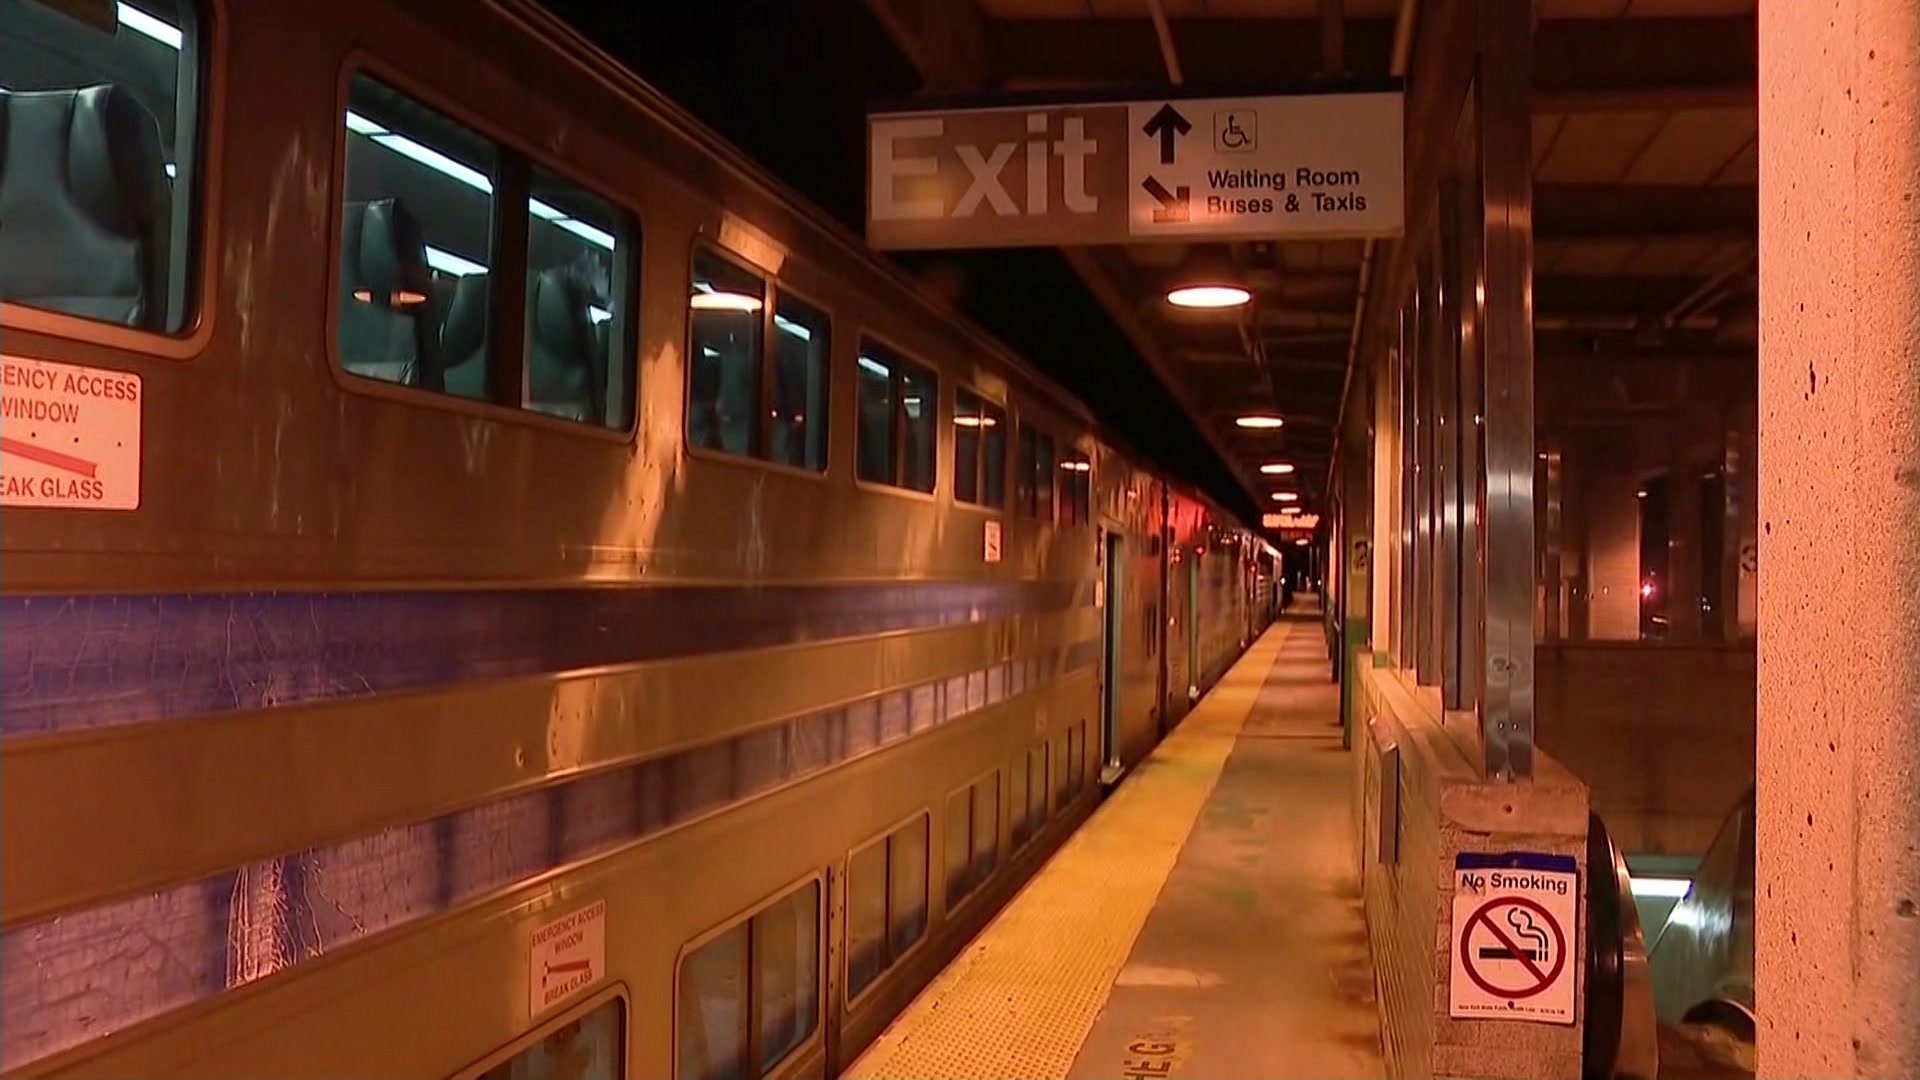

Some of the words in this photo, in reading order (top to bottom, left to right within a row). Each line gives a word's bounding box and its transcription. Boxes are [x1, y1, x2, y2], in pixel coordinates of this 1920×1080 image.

[870, 113, 1099, 222] Exit
[1207, 169, 1286, 191] Waiting
[1296, 168, 1360, 186] Room
[1207, 196, 1273, 213] Buses
[1284, 194, 1300, 212] &
[1312, 193, 1367, 211] Taxis
[0, 364, 57, 391] ENCY
[63, 373, 137, 401] ACCESS
[40, 477, 104, 499] GLASS
[1462, 873, 1486, 890] No
[1490, 873, 1568, 895] Smoking
